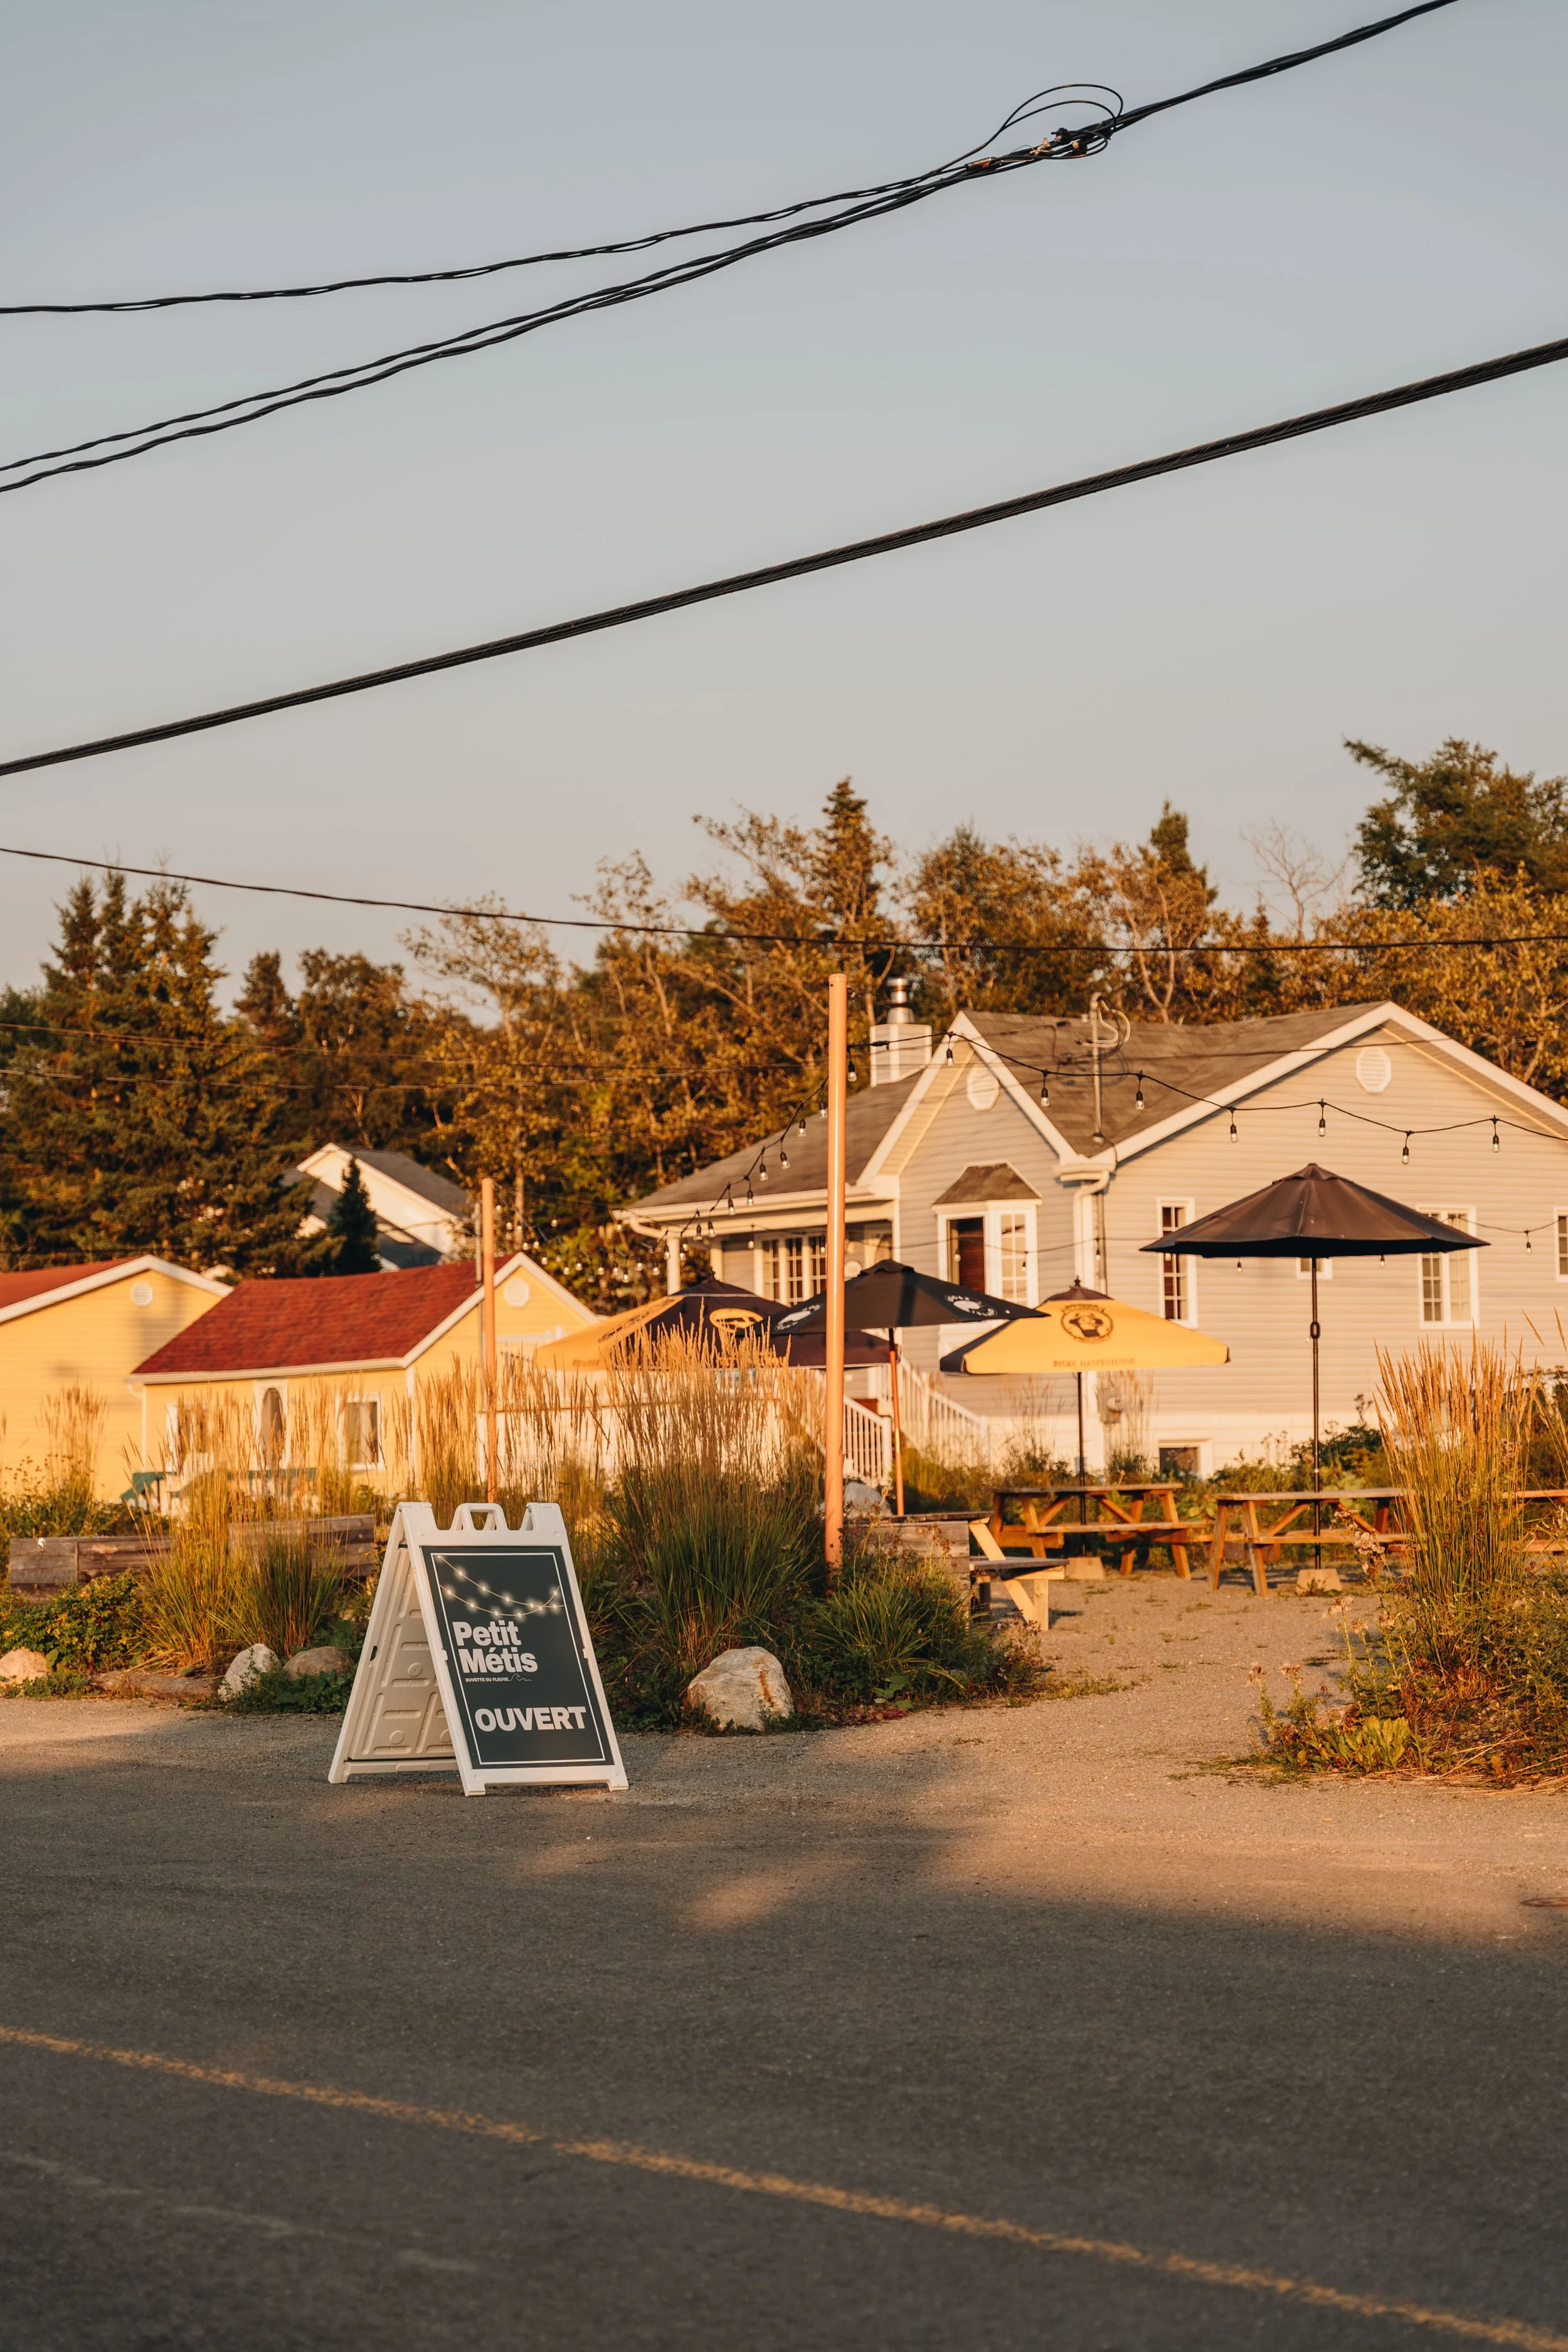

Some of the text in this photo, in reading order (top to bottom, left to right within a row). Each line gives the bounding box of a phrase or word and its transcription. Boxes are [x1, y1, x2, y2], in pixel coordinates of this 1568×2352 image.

[452, 1620, 522, 1646] Petit
[458, 1647, 538, 1673] Métis
[475, 1707, 586, 1732] OUVERT
